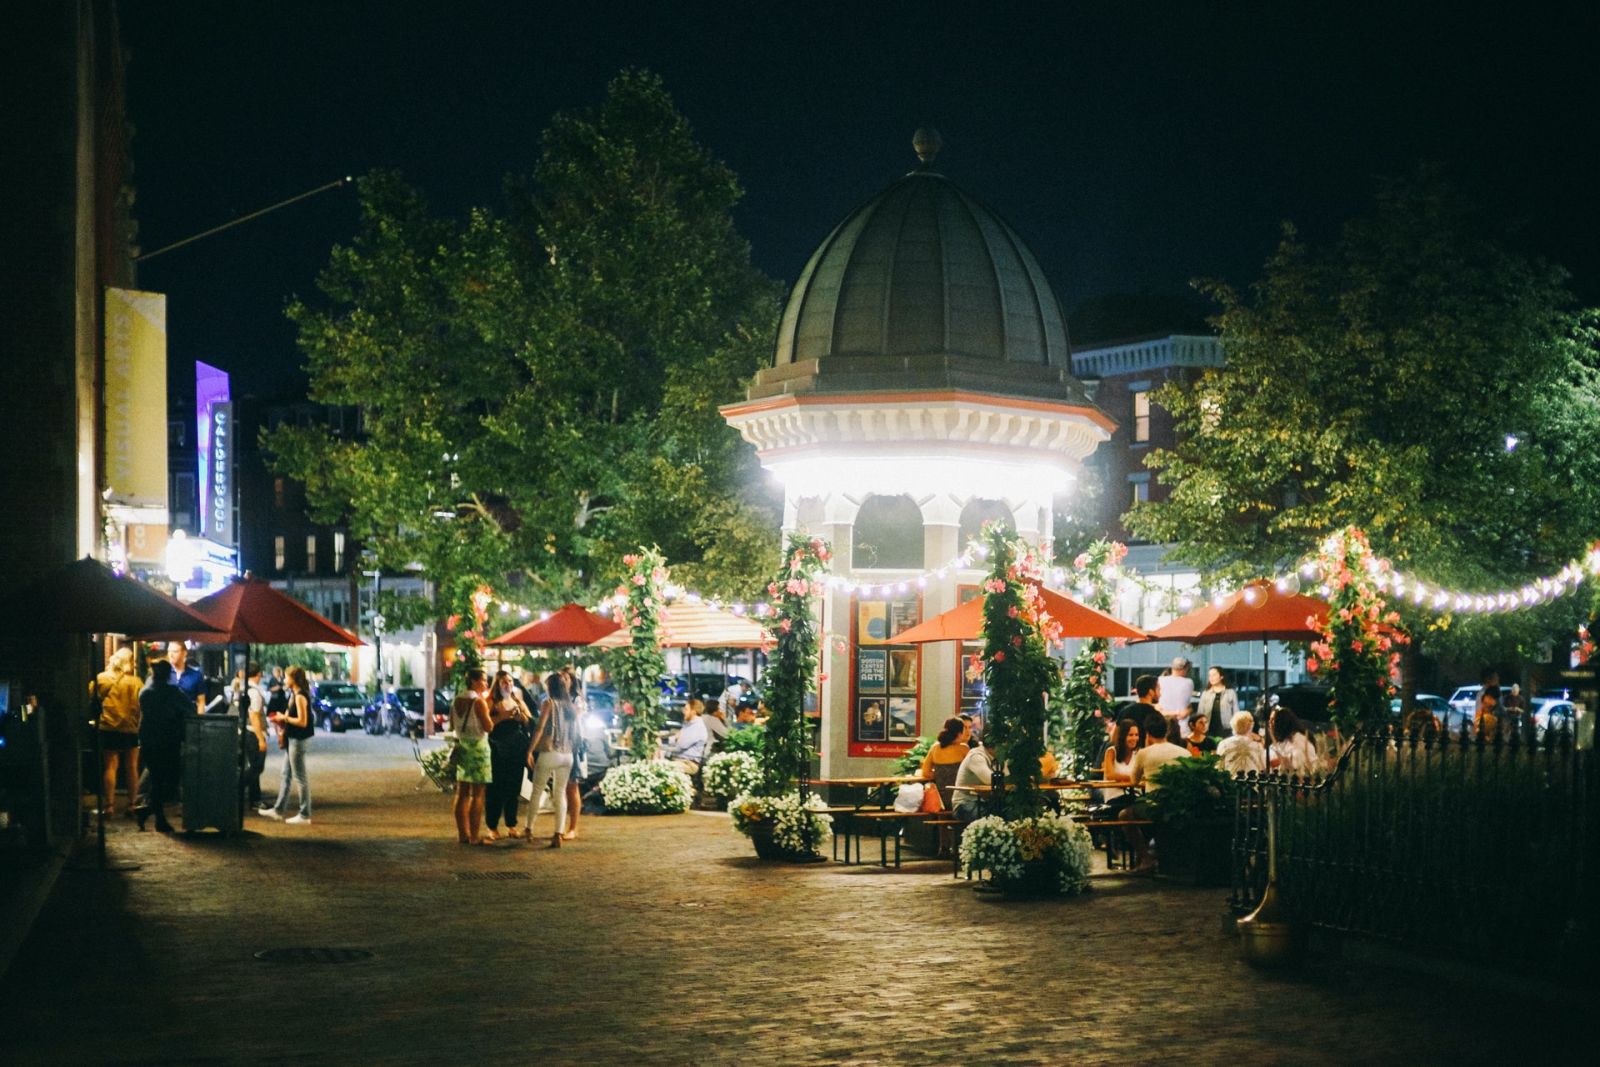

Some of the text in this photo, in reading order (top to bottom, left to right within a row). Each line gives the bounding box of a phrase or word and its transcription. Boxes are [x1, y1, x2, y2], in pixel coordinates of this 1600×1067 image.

[114, 313, 130, 477] VISUAL ARTS
[214, 411, 227, 533] CALDERWOOD
